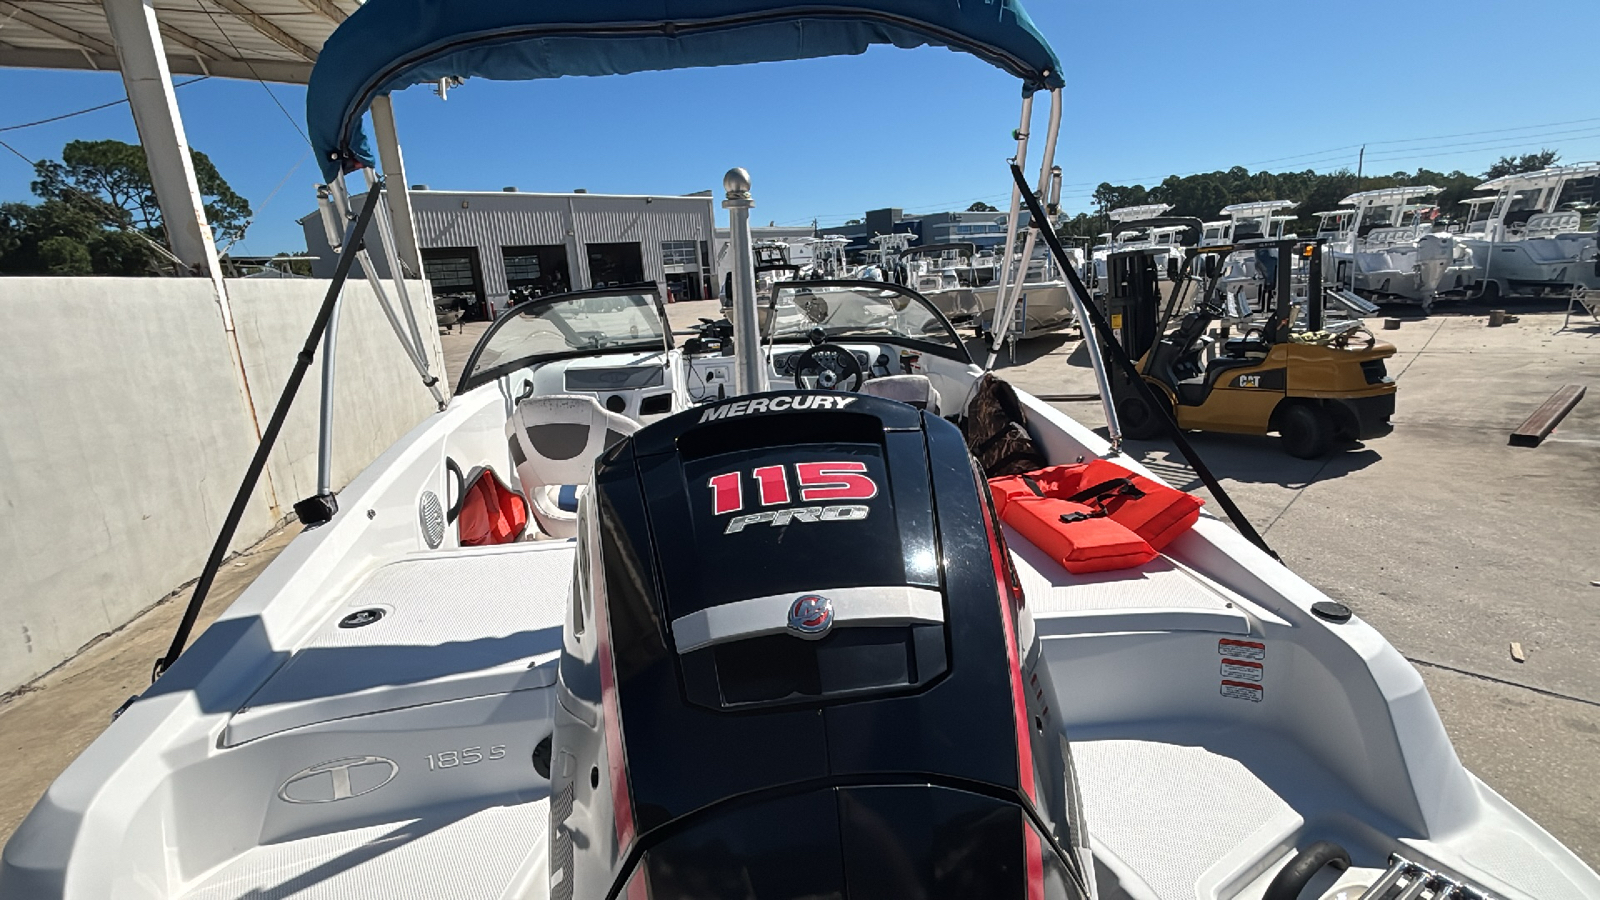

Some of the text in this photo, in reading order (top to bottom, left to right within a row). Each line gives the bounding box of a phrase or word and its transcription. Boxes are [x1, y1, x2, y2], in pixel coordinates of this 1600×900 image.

[1240, 375, 1261, 388] CAT
[698, 395, 858, 424] MERCURY
[708, 461, 880, 516] 115
[723, 505, 870, 535] PRO
[424, 746, 484, 772] 185
